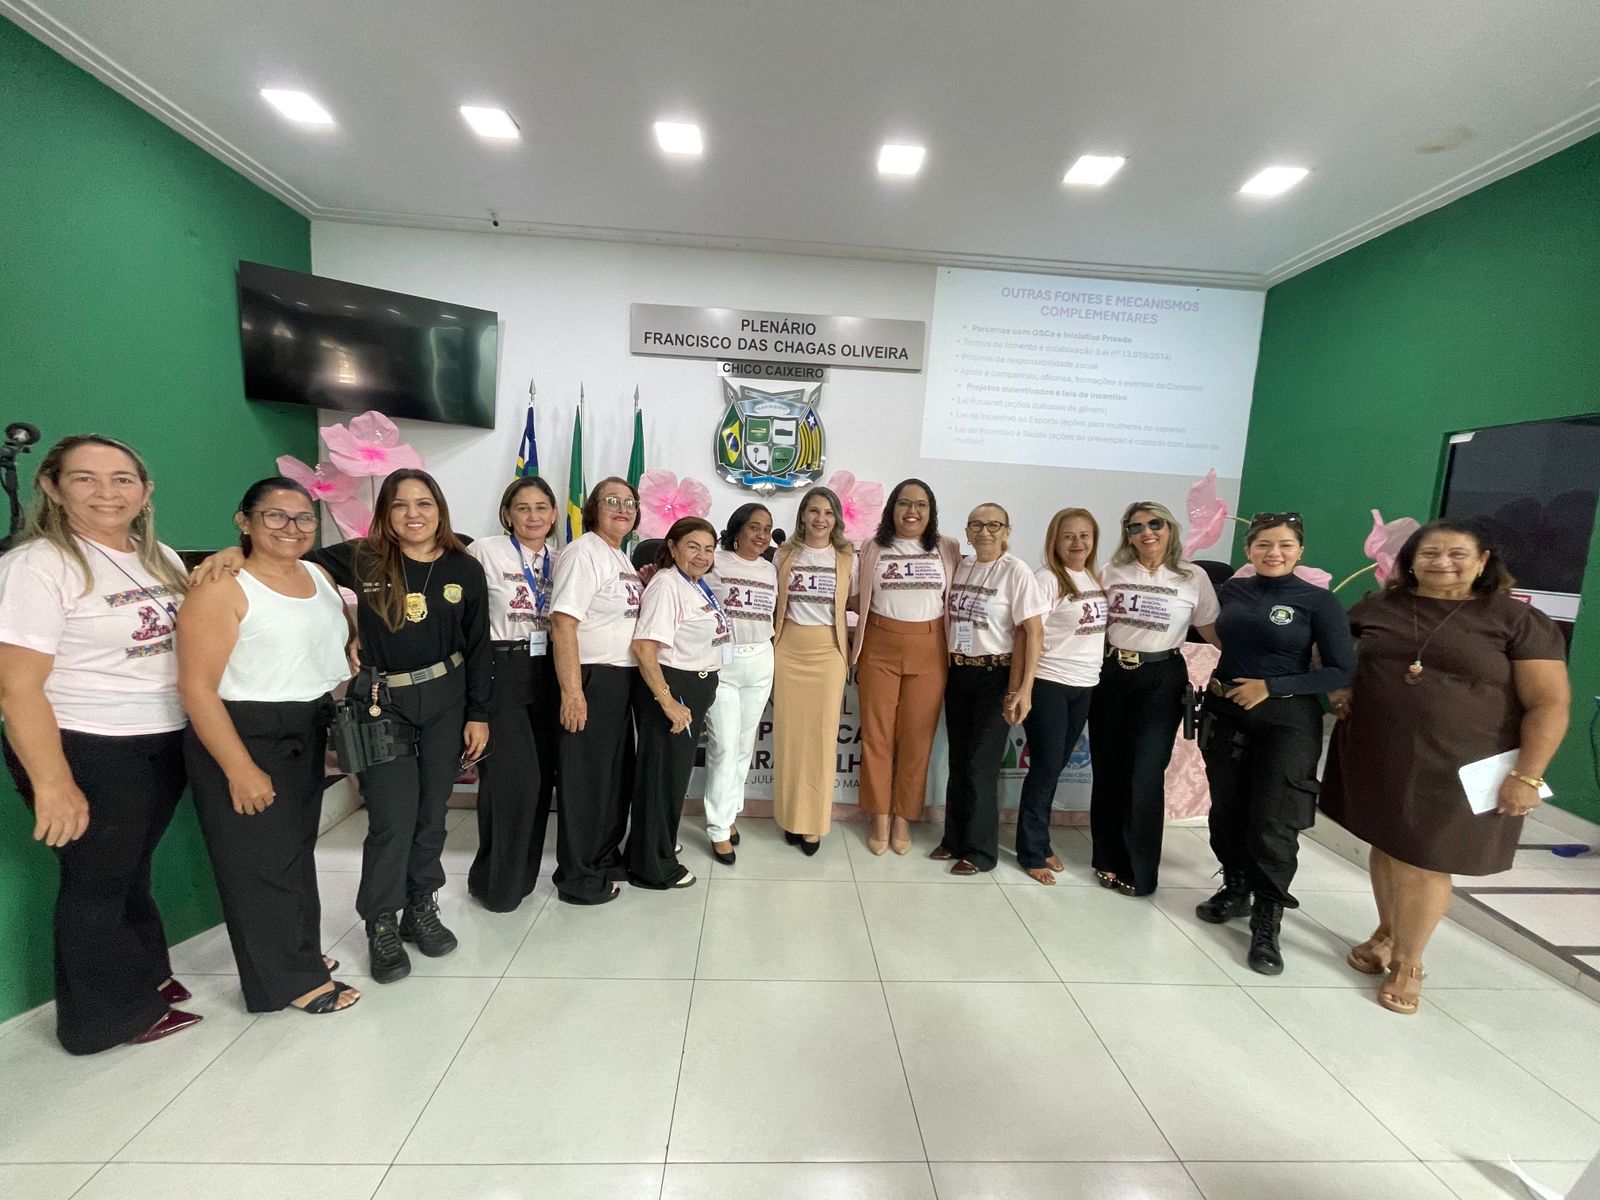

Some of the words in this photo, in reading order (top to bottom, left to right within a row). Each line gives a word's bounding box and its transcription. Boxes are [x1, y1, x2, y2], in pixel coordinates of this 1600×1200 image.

[1001, 286, 1051, 301] OUTRAS
[1054, 290, 1103, 305] FONTES
[1105, 295, 1114, 306] E
[1115, 296, 1200, 312] MECANISMOS
[1040, 305, 1159, 325] COMPLEMENTARES
[741, 318, 817, 336] PLENÁRIO
[1012, 328, 1031, 337] com
[644, 331, 732, 350] FRANCISCO
[737, 337, 768, 352] DAS
[774, 340, 837, 356] CHAGAS
[841, 344, 909, 360] OLIVEIRA
[722, 362, 762, 375] CHICO
[765, 365, 824, 379] CAIXEIRO
[1078, 391, 1089, 399] de
